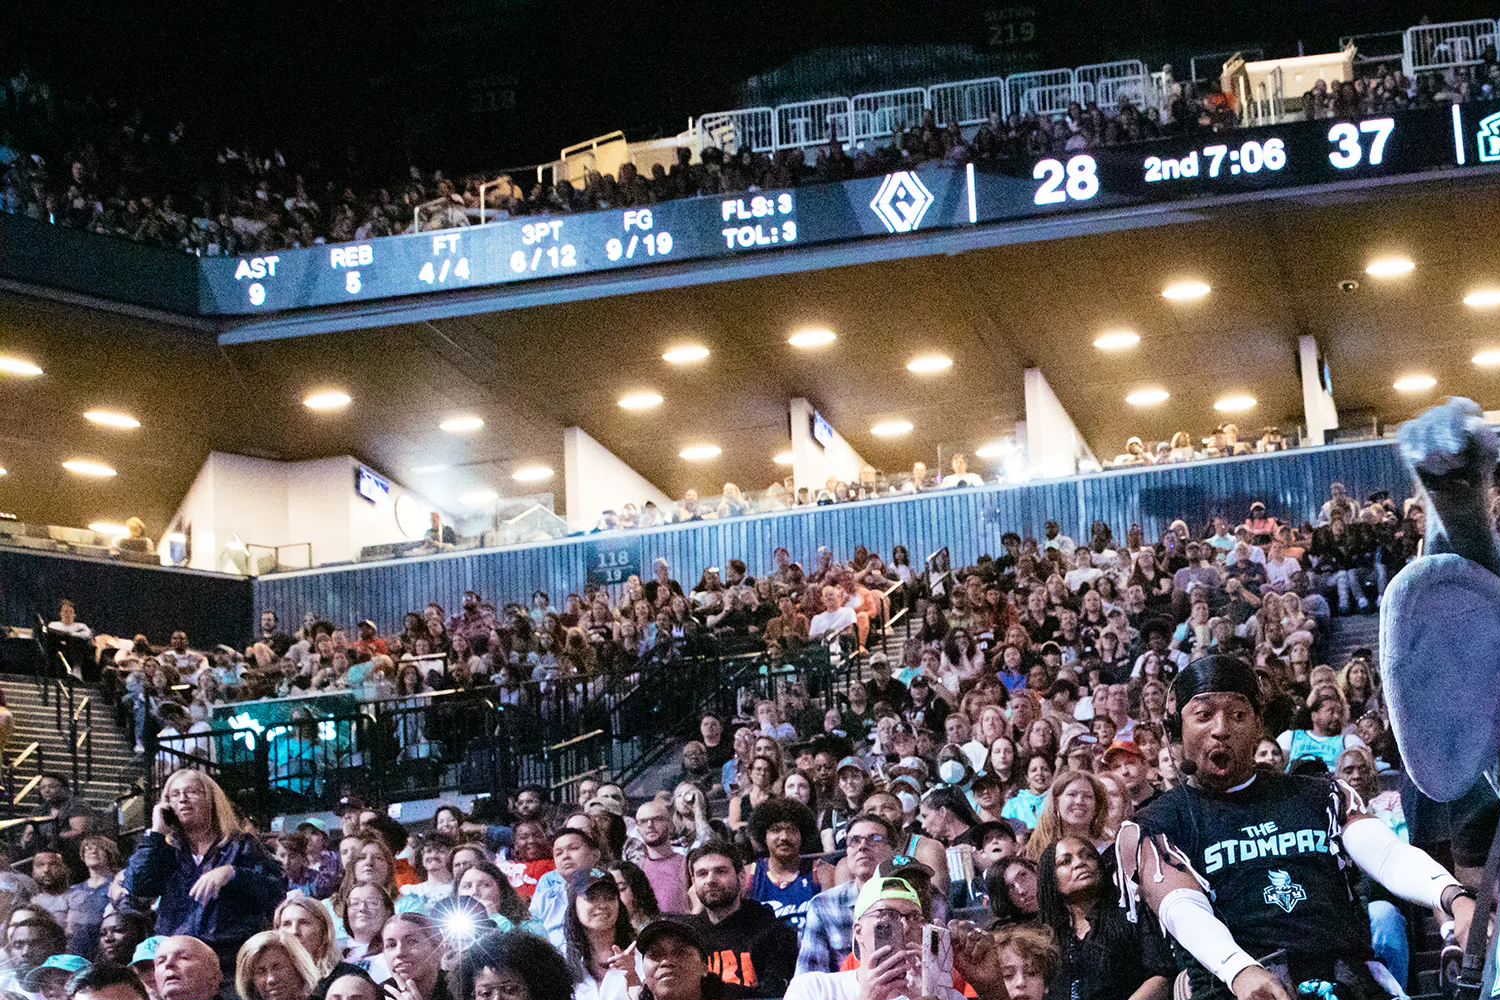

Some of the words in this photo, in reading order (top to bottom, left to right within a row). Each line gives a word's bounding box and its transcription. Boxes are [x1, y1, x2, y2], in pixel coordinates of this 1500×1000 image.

[1328, 117, 1395, 170] 37
[1143, 151, 1199, 182] 2nd
[1203, 137, 1287, 178] 7:06
[1032, 153, 1100, 206] 28
[623, 208, 654, 231] FG
[721, 196, 775, 222] FLS:
[779, 193, 794, 216] 3
[432, 233, 462, 256] FT
[521, 220, 564, 246] 3PT
[721, 224, 780, 250] TOL:
[782, 220, 798, 243] 3
[234, 255, 281, 280] AST
[330, 244, 375, 269] REB
[249, 282, 267, 307] 9
[345, 270, 363, 295] 5
[597, 550, 630, 568] 118
[1241, 820, 1279, 839] THE
[1203, 828, 1329, 875] STOMPAZ
